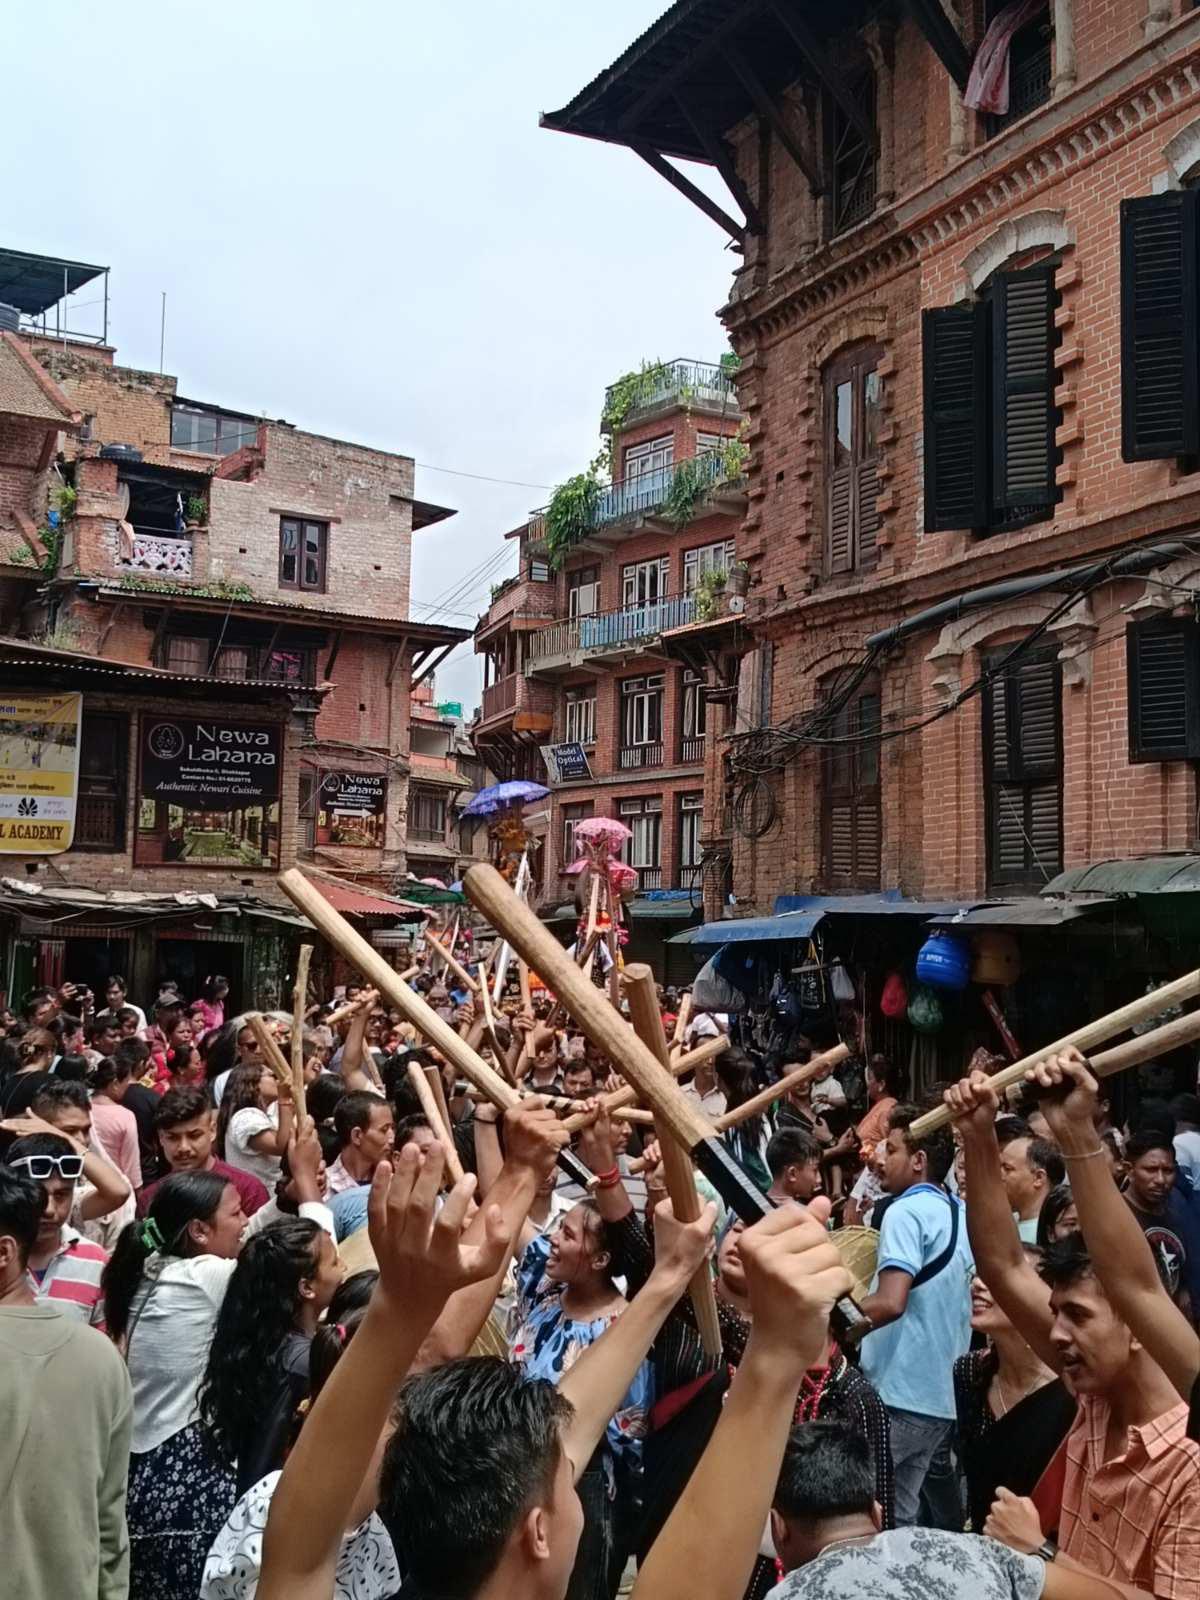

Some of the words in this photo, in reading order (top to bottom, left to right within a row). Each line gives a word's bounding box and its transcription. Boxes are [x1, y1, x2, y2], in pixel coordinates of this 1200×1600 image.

[196, 724, 269, 745] Newa
[188, 744, 276, 765] Lahana
[557, 747, 577, 755] Model
[557, 754, 583, 766] Optical
[345, 774, 381, 785] Newa
[156, 781, 198, 792] Authentic
[199, 783, 230, 794] Newari
[231, 784, 263, 795] Cuisine
[341, 784, 383, 795] Lahana
[8, 825, 64, 840] ACADEMY
